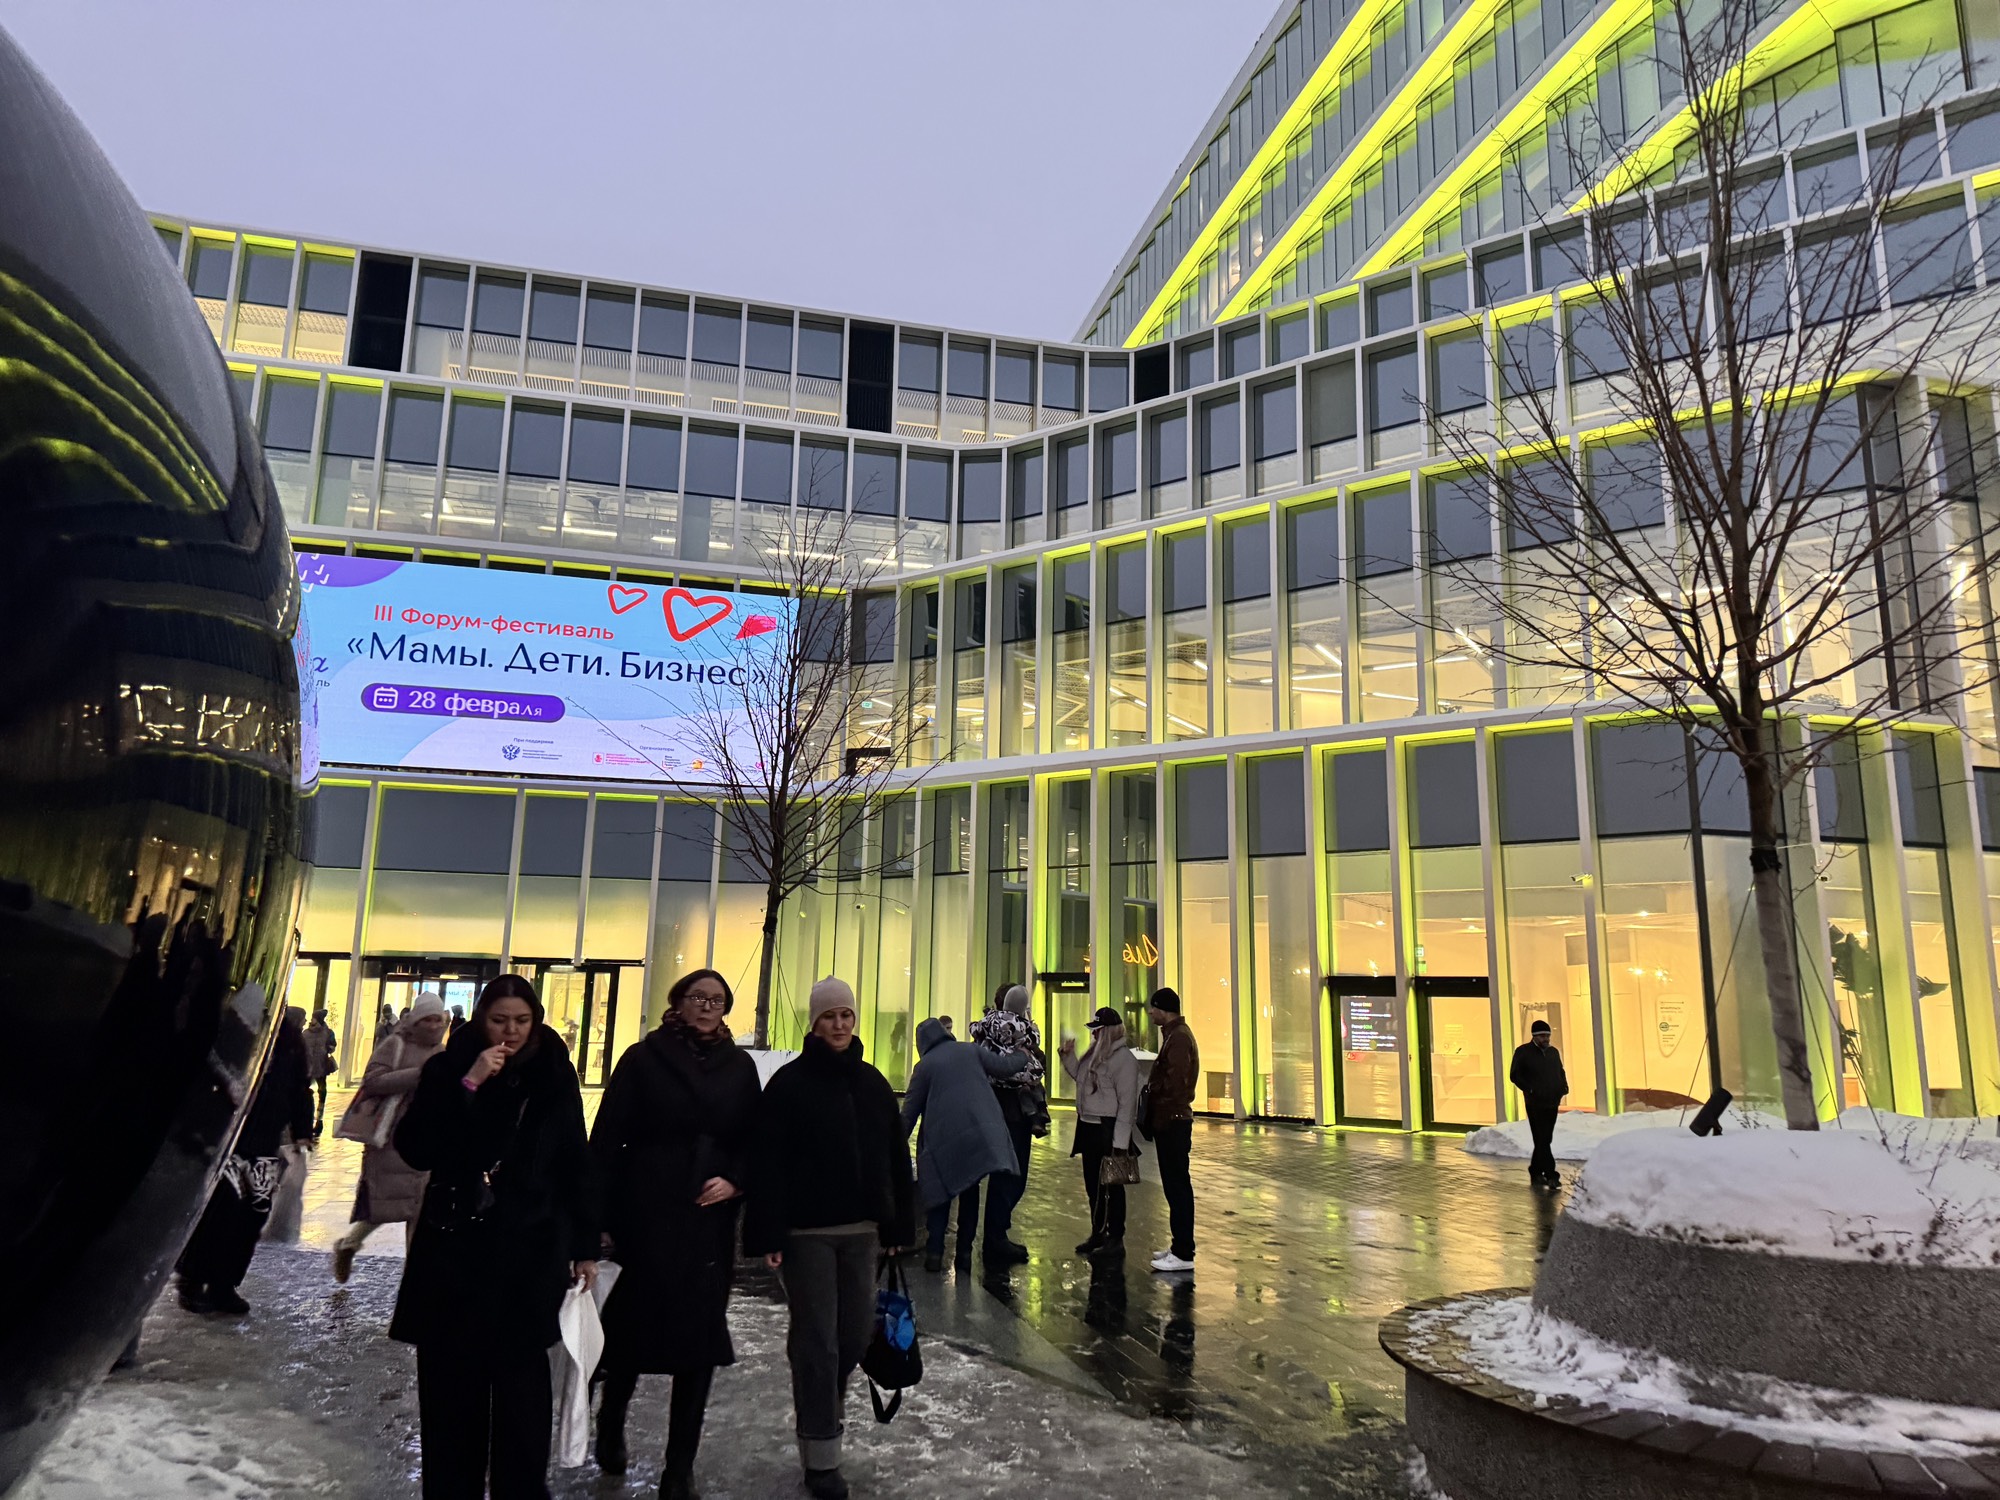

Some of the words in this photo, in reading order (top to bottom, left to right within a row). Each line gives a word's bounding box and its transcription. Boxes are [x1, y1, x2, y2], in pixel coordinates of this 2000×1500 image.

[401, 607, 615, 640] Форум-фестиваль
[347, 632, 493, 668] «Мамы.
[503, 643, 611, 677] Дети.
[620, 651, 767, 686] Бизнес»
[408, 690, 436, 708] 28
[443, 692, 543, 719] февраля
